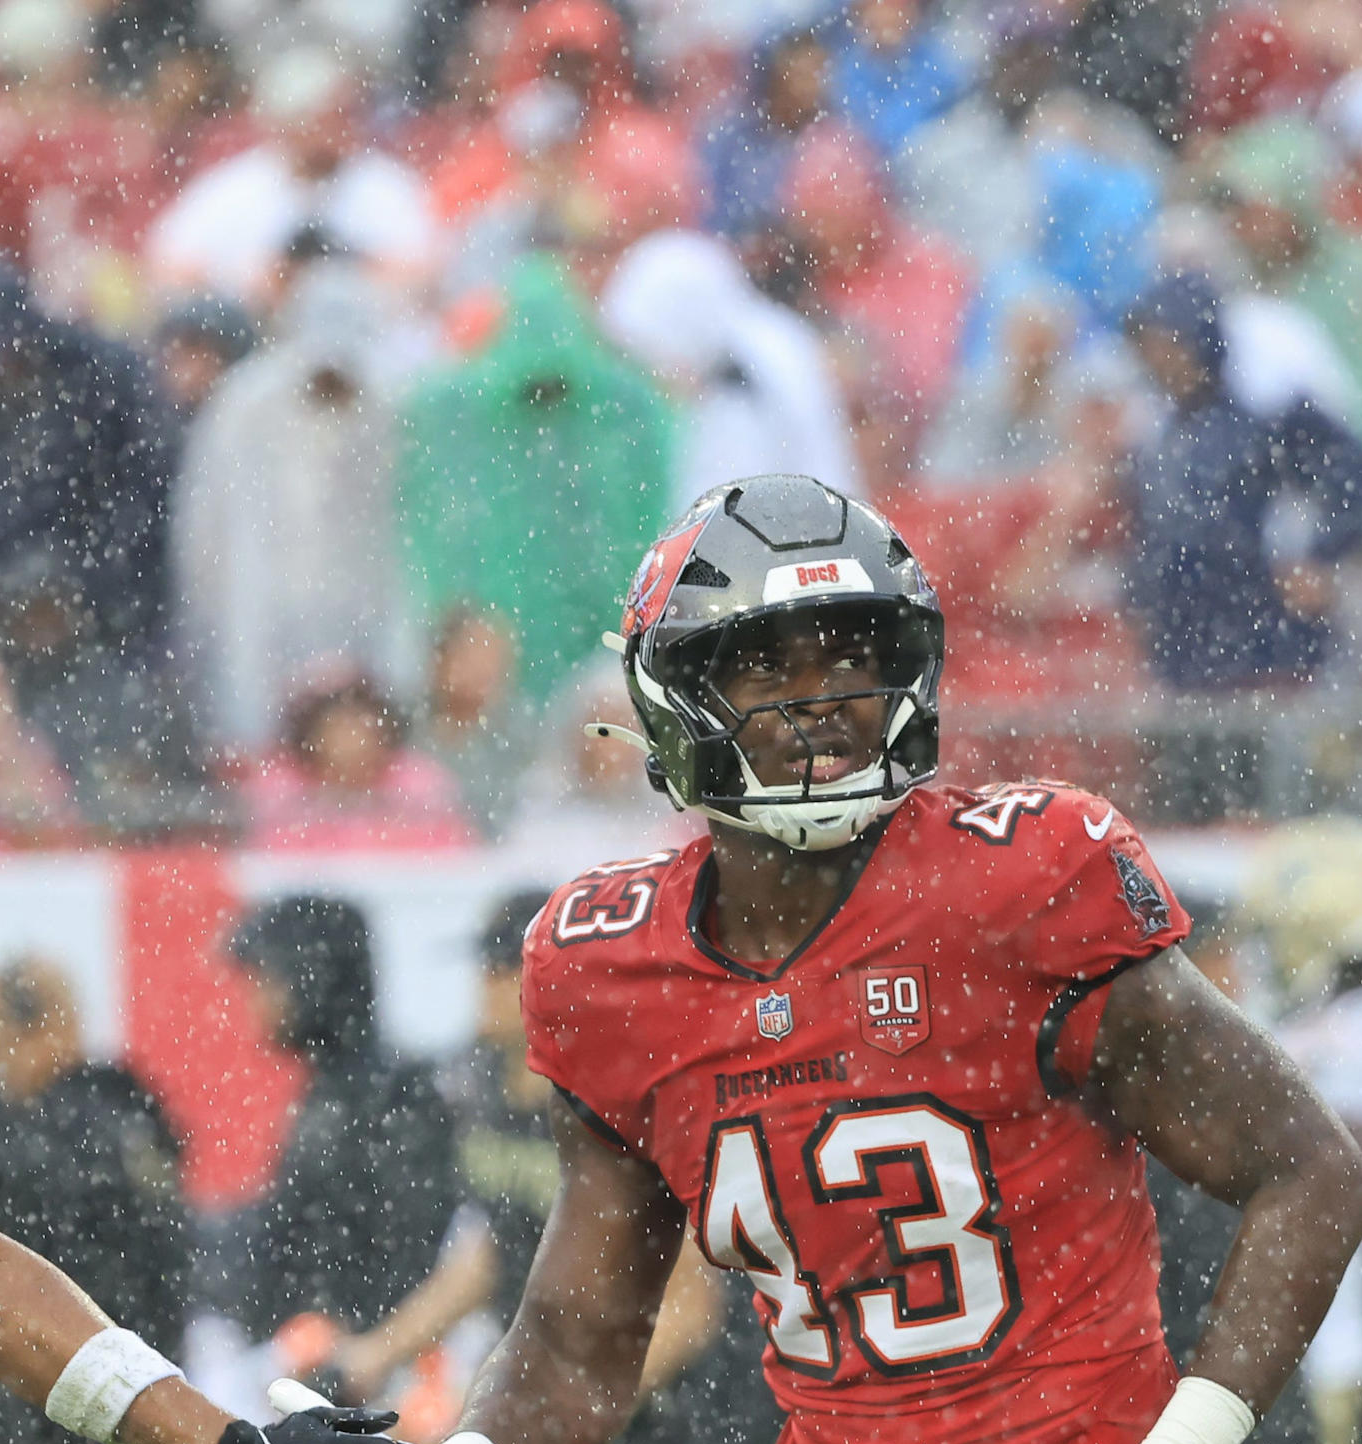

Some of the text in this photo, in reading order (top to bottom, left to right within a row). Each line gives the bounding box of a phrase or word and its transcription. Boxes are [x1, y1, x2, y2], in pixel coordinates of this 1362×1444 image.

[949, 777, 1056, 846] 4
[762, 1012, 788, 1033] NFL
[866, 976, 920, 1017] 50
[698, 1091, 1025, 1381] 43
